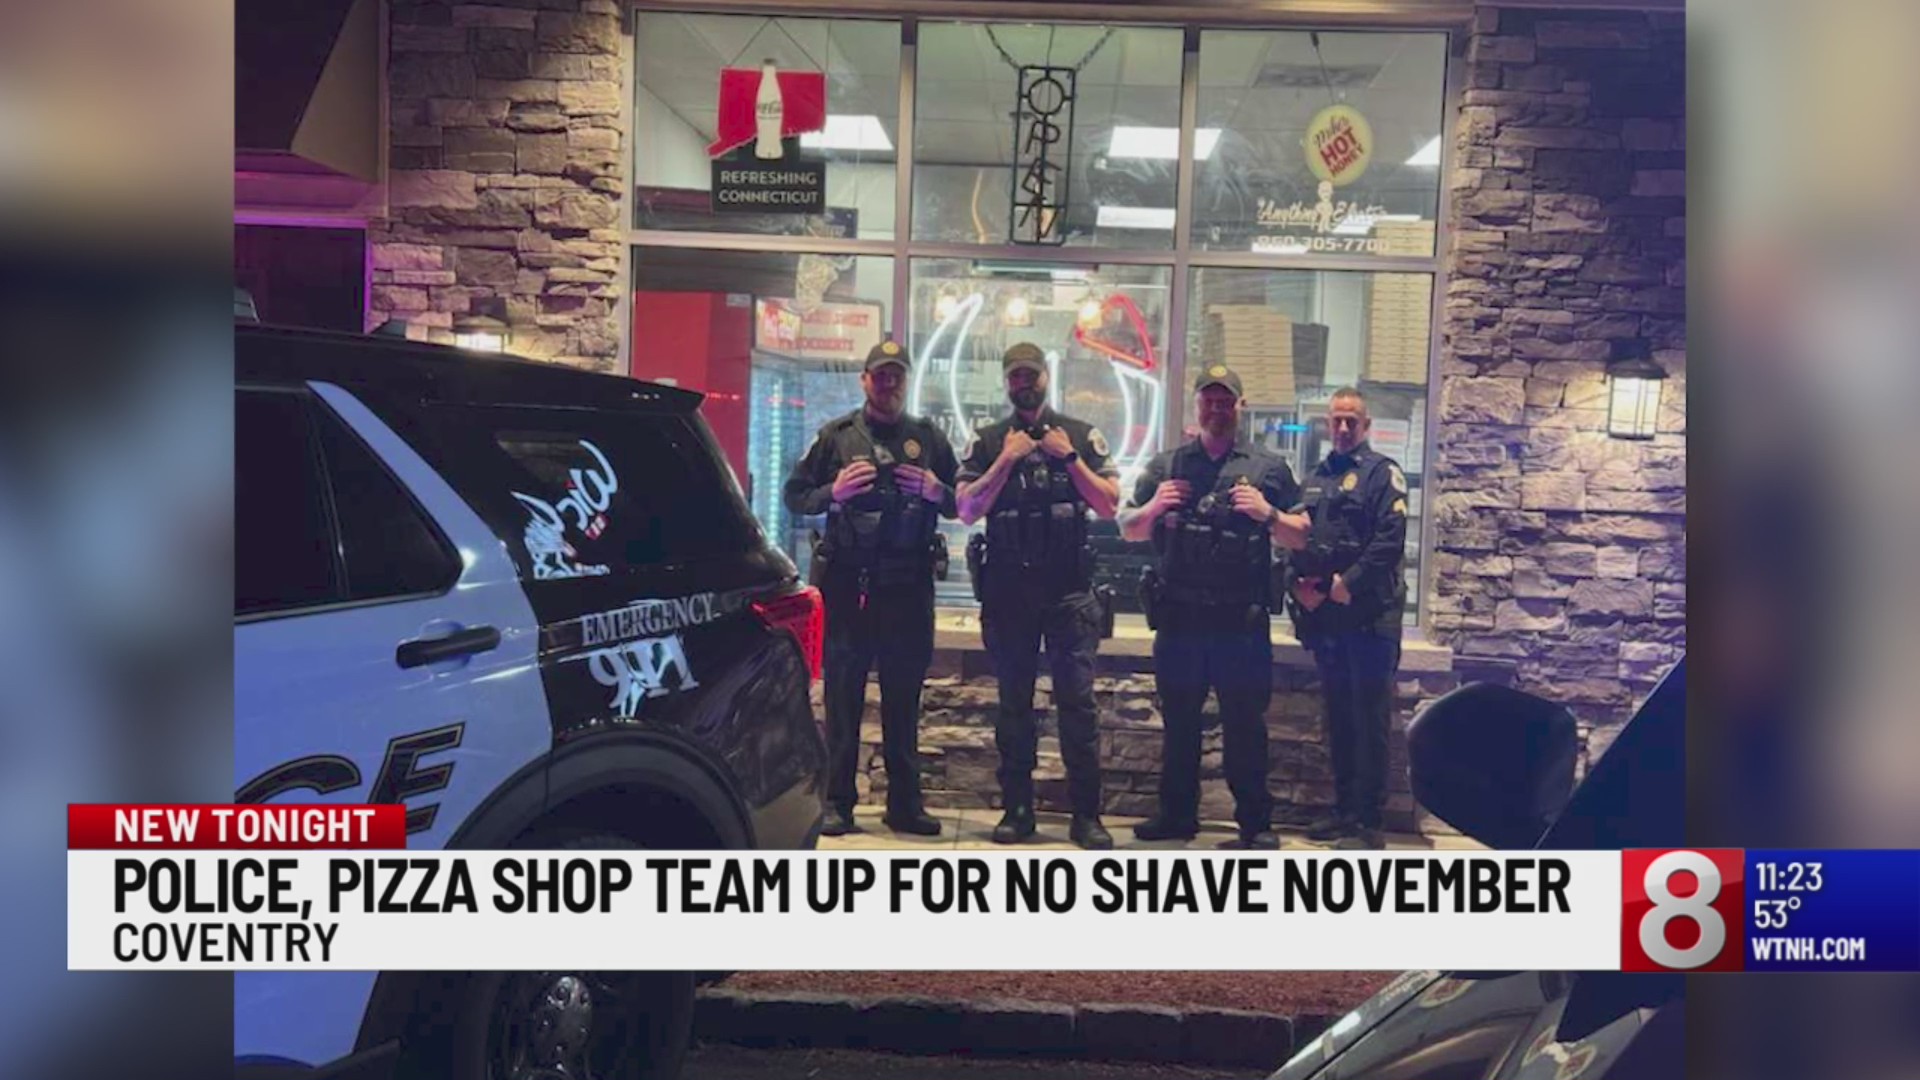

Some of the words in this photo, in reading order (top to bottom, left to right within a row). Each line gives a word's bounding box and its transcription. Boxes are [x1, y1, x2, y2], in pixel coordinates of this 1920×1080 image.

[1320, 126, 1357, 166] HOT
[720, 170, 818, 185] REFRESHING
[718, 189, 819, 205] CONNECTICUT
[582, 592, 714, 645] EMERGENCY
